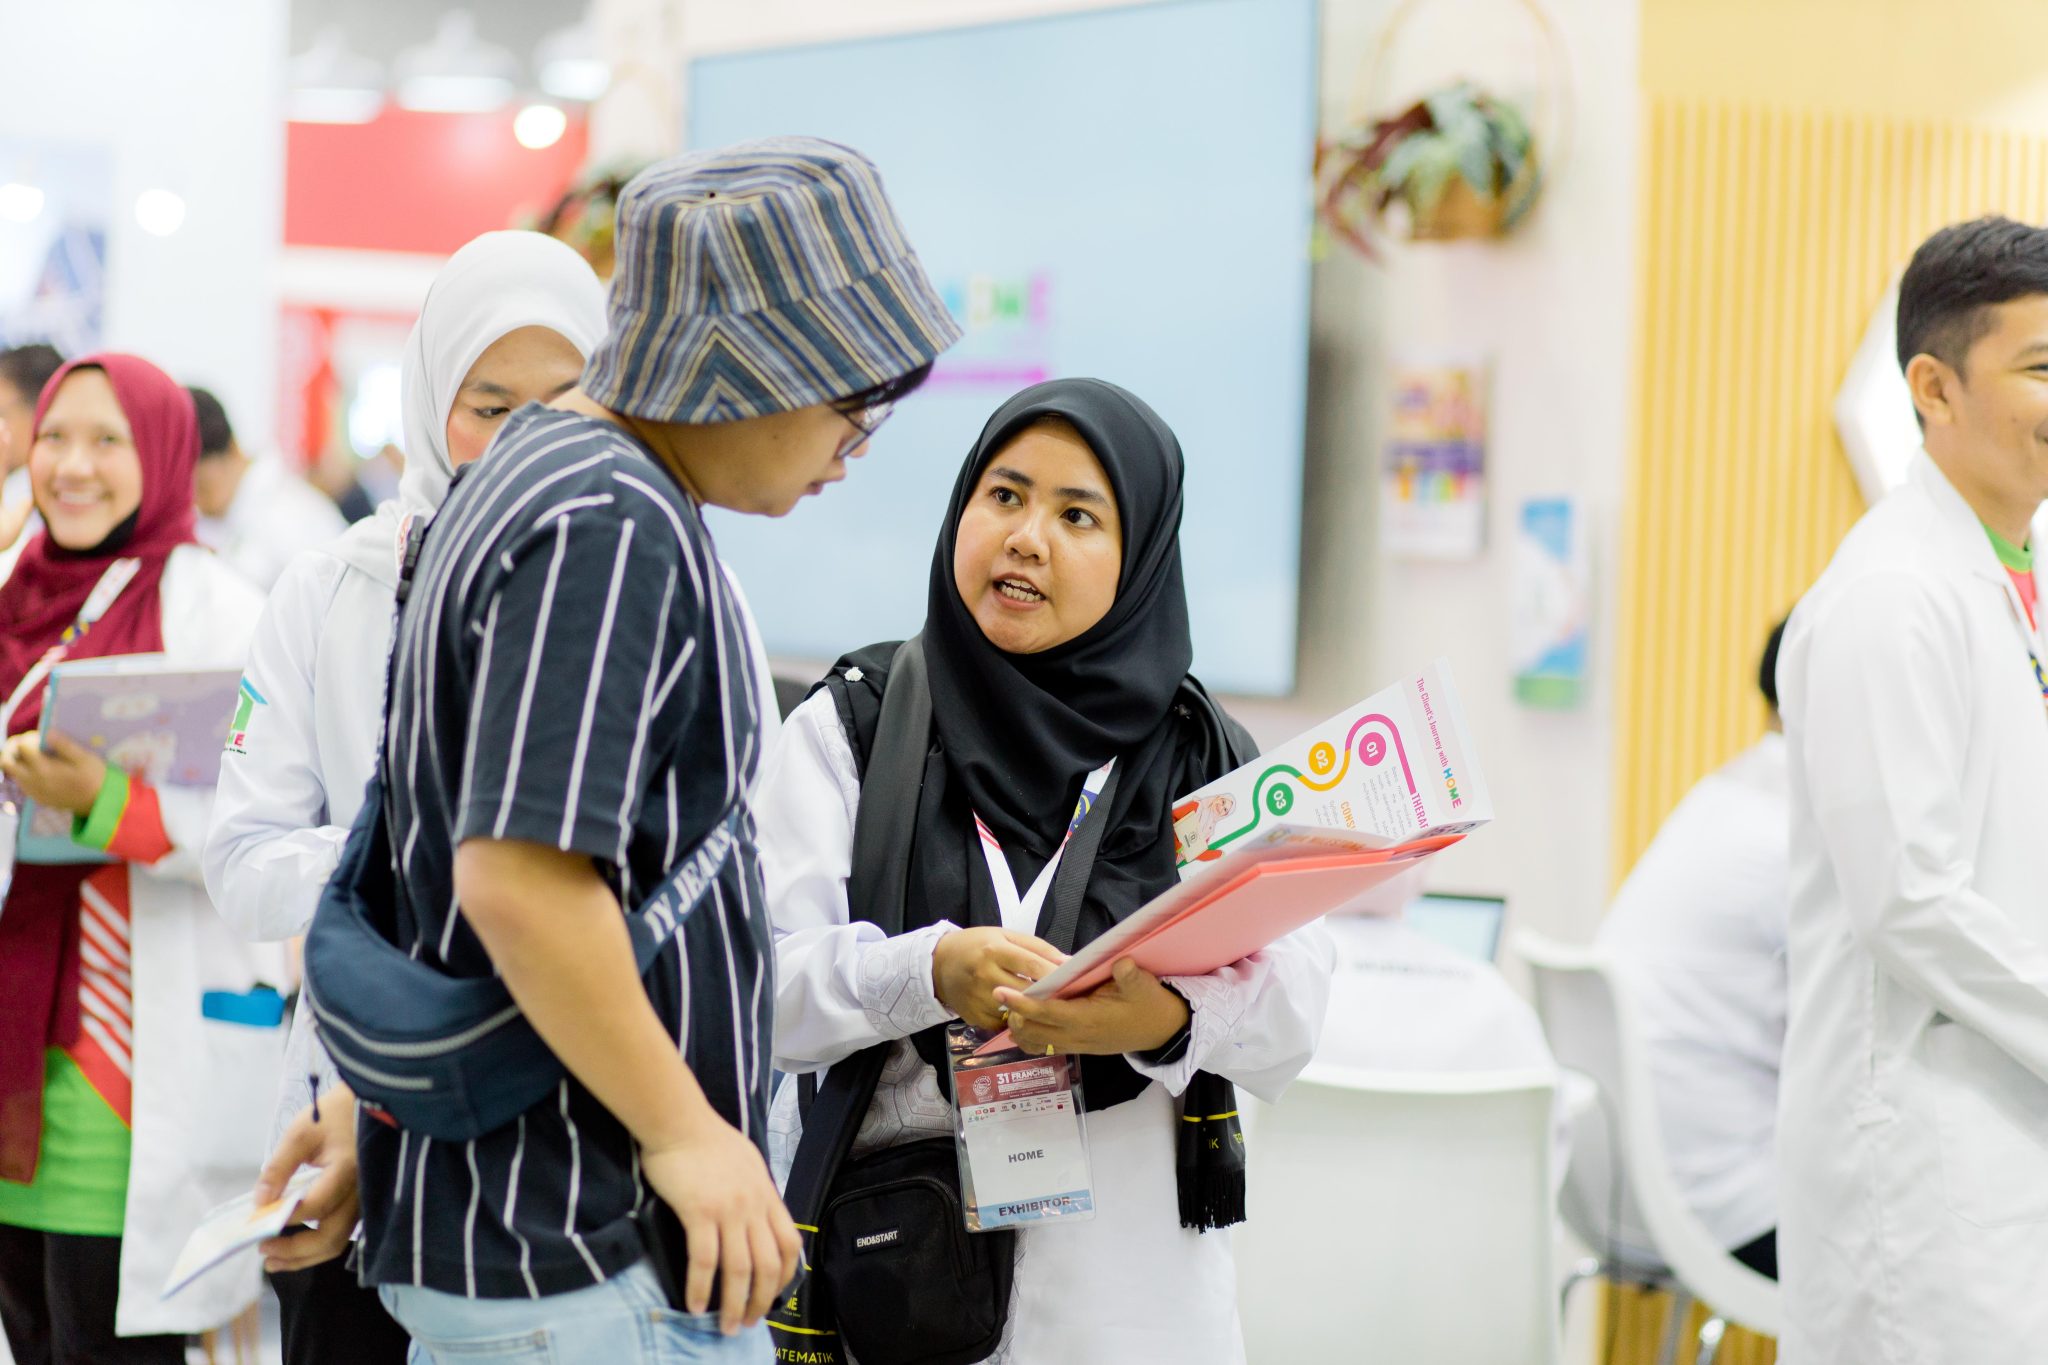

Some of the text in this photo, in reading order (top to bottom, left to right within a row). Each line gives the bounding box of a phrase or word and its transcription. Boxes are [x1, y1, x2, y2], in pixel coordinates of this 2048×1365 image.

[1366, 741, 1379, 759] 01
[1416, 677, 1462, 809] The Client's Journey with HOME
[1315, 750, 1328, 769] 02
[1273, 790, 1286, 809] 03
[1340, 801, 1357, 830] CONS
[1008, 1149, 1045, 1163] HOME
[998, 1196, 1071, 1217] EXHIBITOR
[856, 1230, 899, 1248] END&START
[774, 1346, 835, 1364] ATEMATIK
